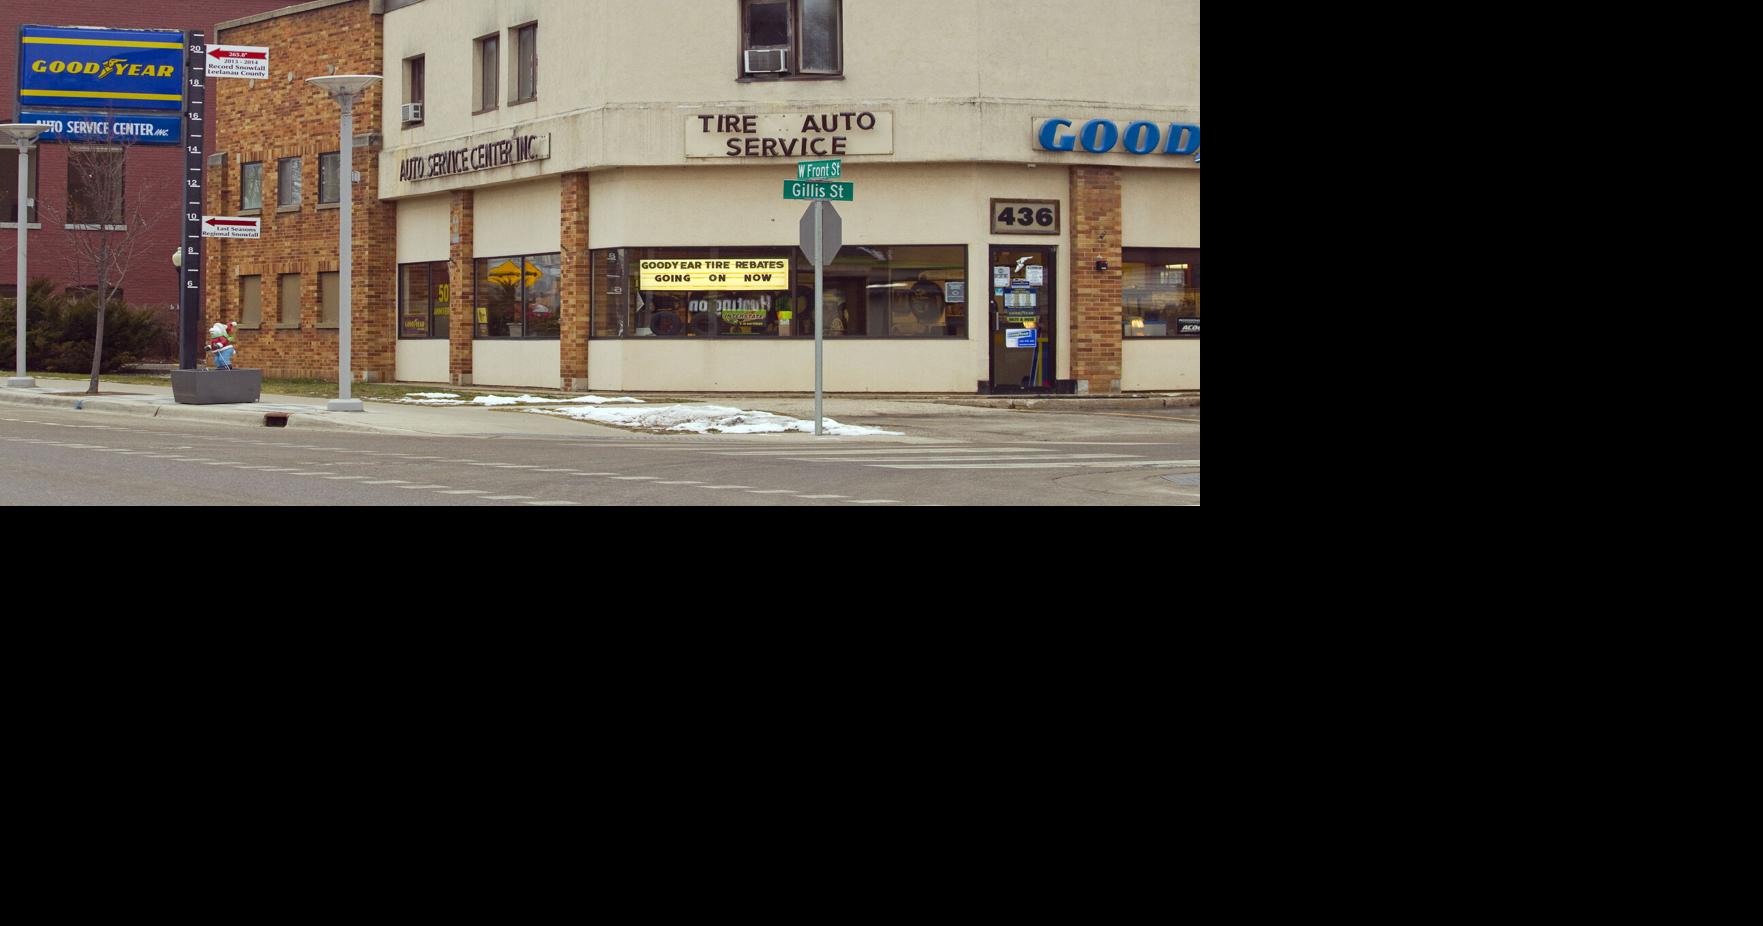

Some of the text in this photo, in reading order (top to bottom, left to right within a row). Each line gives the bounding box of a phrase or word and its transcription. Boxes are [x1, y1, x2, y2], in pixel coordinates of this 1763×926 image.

[66, 120, 109, 135] SERVICE
[113, 122, 154, 136] CENTER
[698, 111, 876, 134] TIRE AUTO
[726, 136, 848, 157] SERVICE
[400, 155, 425, 182] AUTO
[427, 148, 469, 177] SERVICE
[470, 140, 513, 171] CENTER
[798, 162, 841, 178] W Front St
[792, 183, 844, 198] Gillis St
[997, 207, 1054, 226] 436
[641, 260, 785, 270] GOODYEAR TIRE REBATES
[655, 274, 772, 282] GOING ON NOW
